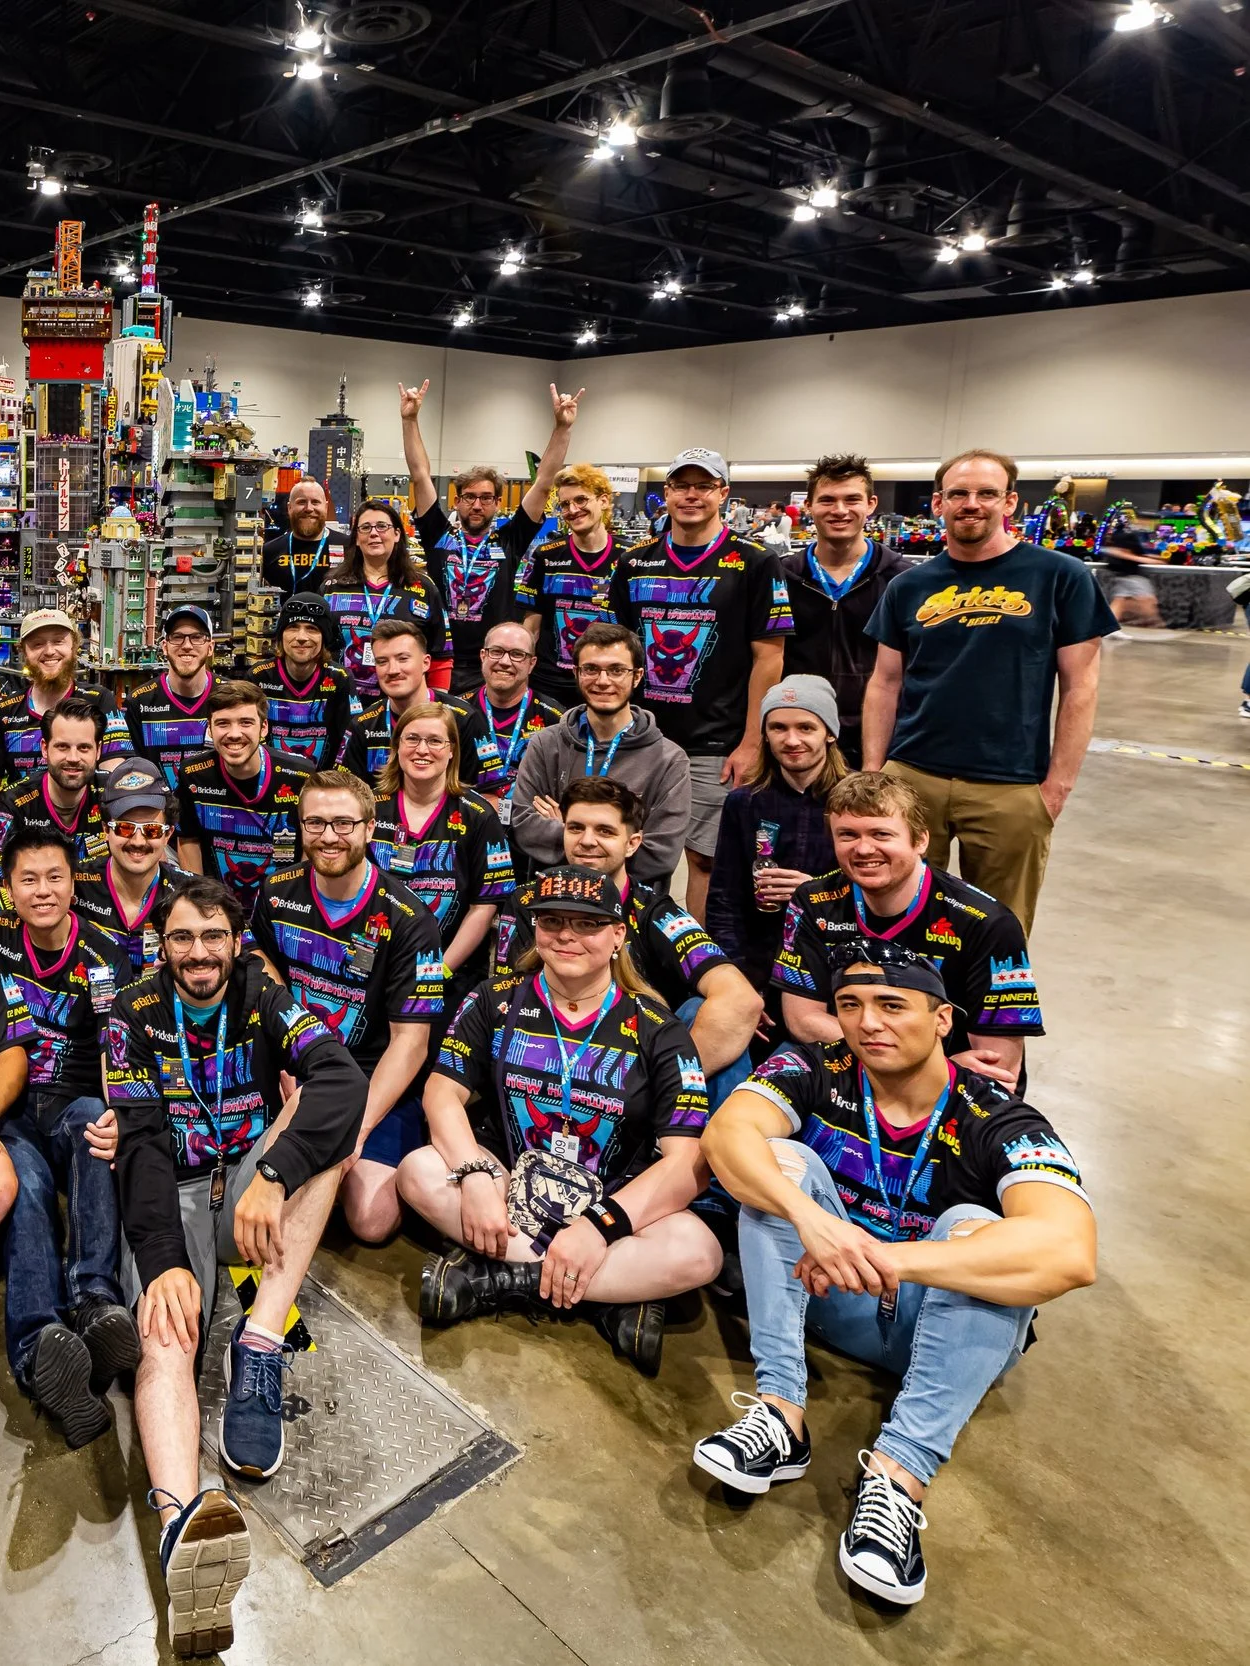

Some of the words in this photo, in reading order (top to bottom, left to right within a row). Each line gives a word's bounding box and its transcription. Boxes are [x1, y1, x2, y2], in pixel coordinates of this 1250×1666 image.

[245, 487, 254, 500] 7
[718, 558, 745, 571] brolug
[916, 585, 1029, 622] Bricks
[958, 615, 968, 625] &
[966, 614, 1002, 628] BEER!
[363, 646, 371, 663] 0970
[143, 704, 171, 713] Brickstuff
[186, 759, 215, 774] REBELLUG
[197, 785, 227, 796] Brickstuff
[274, 793, 300, 805] brolug
[272, 868, 305, 884] REBELLUG
[78, 898, 112, 916] Brickstuff
[278, 898, 312, 914] Brickstuff
[943, 895, 989, 921] eclipseGRAFX
[925, 928, 963, 951] brolug
[983, 994, 998, 1004] 02
[1000, 992, 1032, 1002] INNER
[519, 1007, 541, 1018] stuff
[136, 1067, 149, 1079] JJ
[505, 1072, 543, 1095] NEW
[865, 1095, 880, 1140] Brickworld
[922, 1109, 942, 1150] Brickworld
